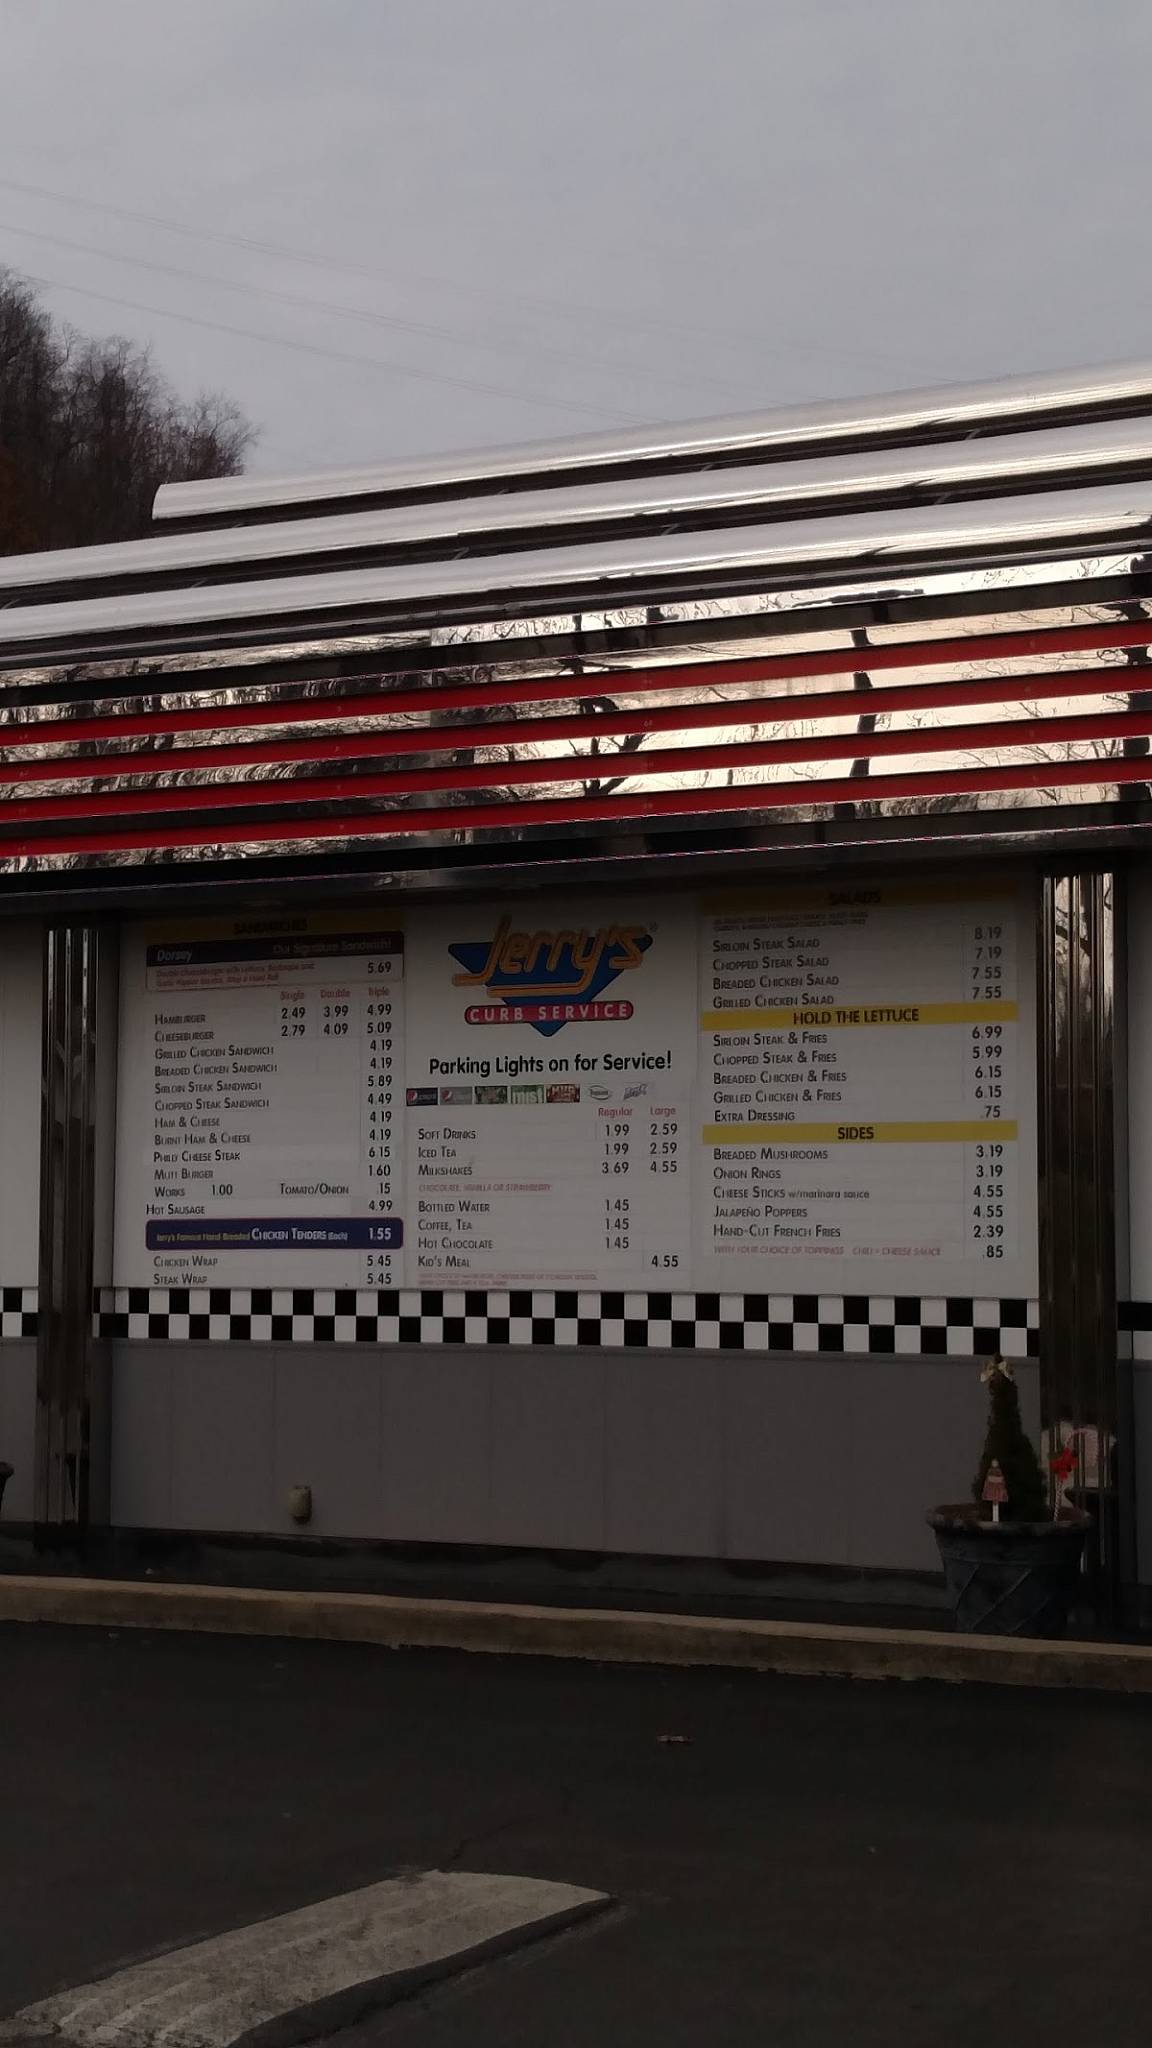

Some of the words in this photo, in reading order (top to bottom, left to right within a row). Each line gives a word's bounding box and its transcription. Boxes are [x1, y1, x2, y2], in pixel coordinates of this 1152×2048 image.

[753, 938, 784, 950] STEAK
[788, 936, 819, 948] SALAD
[975, 927, 1001, 940] 8.19
[451, 914, 648, 998] Jerry's
[713, 959, 758, 970] CHOPPED
[762, 957, 793, 968] STEAK
[797, 955, 829, 966] SALAD
[976, 946, 1001, 959] 7.19
[368, 961, 392, 973] 5.69
[713, 978, 755, 990] BREADED
[760, 976, 803, 987] CHICKEN
[807, 974, 839, 986] SALAD
[972, 966, 1001, 979] 7.55
[713, 997, 751, 1009] GRILLED
[755, 995, 798, 1006] CHICKEN
[802, 994, 834, 1005] SALAD
[972, 986, 1001, 999] 7.55
[281, 1007, 305, 1019] 2.49
[324, 1005, 348, 1017] 3.99
[368, 1004, 392, 1015] 4.99
[470, 1005, 523, 1022] CURB
[538, 1002, 628, 1020] SERVICE
[794, 1012, 831, 1025] HOLD
[837, 1011, 859, 1023] THE
[864, 1009, 918, 1022] LETTUCE
[281, 1025, 305, 1037] 2.79
[324, 1023, 348, 1035] 4.09
[368, 1022, 392, 1033] 5.09
[754, 1034, 784, 1045] STEAK
[788, 1033, 798, 1045] &
[802, 1033, 827, 1044] FRIES
[972, 1026, 1002, 1039] 6.99
[229, 1045, 273, 1056] SANDWICH
[370, 1040, 392, 1051] 4.19
[713, 1054, 759, 1066] CHOPPED
[763, 1052, 793, 1063] STEAK
[798, 1052, 807, 1063] &
[812, 1051, 837, 1063] FRIES
[972, 1046, 1002, 1059] 5.99
[155, 1066, 189, 1076] BREADED
[233, 1063, 277, 1073] SANDWICH
[370, 1058, 392, 1068] 4.19
[429, 1056, 490, 1077] Parking
[496, 1055, 543, 1076] Lights
[549, 1057, 568, 1071] on
[575, 1054, 597, 1071] for
[603, 1051, 672, 1071] Service!
[714, 1073, 756, 1084] BREADED
[760, 1071, 803, 1083] CHICKEN
[808, 1071, 817, 1082] &
[822, 1070, 847, 1082] FRIES
[975, 1066, 1001, 1079] 6.15
[188, 1082, 213, 1093] STEAK
[217, 1081, 261, 1091] SANDWICH
[368, 1075, 392, 1087] 5.89
[155, 1100, 192, 1111] CHOPPED
[196, 1099, 221, 1109] STEAK
[224, 1098, 269, 1108] SANDWICH
[368, 1093, 392, 1104] 4.49
[714, 1091, 752, 1103] GRILLED
[756, 1090, 798, 1102] CHICKEN
[802, 1090, 812, 1101] &
[816, 1090, 841, 1101] FRIES
[975, 1086, 1001, 1098] 6.15
[155, 1117, 175, 1128] HAM
[179, 1117, 186, 1127] &
[190, 1116, 220, 1127] CHEESE
[370, 1111, 392, 1123] 4.19
[599, 1107, 632, 1118] Regular
[650, 1106, 676, 1117] Large
[714, 1111, 743, 1121] EXTRA
[748, 1110, 795, 1121] DRESSING
[184, 1133, 205, 1144] HAM
[209, 1133, 217, 1143] &
[221, 1133, 250, 1143] CHEESE
[369, 1129, 391, 1141] 4.19
[418, 1128, 440, 1140] SOFT
[444, 1128, 476, 1139] DRINKS
[605, 1125, 629, 1136] 1.99
[650, 1123, 678, 1136] 2.59
[838, 1127, 874, 1140] SIDES
[182, 1151, 211, 1161] CHEESE
[215, 1150, 240, 1160] STEAK
[369, 1147, 390, 1158] 6.15
[418, 1147, 436, 1158] ICED
[441, 1146, 456, 1157] TEA
[604, 1143, 628, 1155] 1.99
[650, 1142, 677, 1154] 2.59
[714, 1149, 756, 1160] BREADED
[761, 1148, 828, 1159] MUSHROOMS
[976, 1145, 1003, 1158] 3.19
[602, 1162, 628, 1174] 3.69
[650, 1161, 677, 1173] 4.55
[714, 1168, 747, 1180] ONION
[752, 1167, 781, 1179] RINGS
[976, 1165, 1003, 1177] 3.19
[155, 1186, 185, 1197] WORKS
[212, 1184, 233, 1195] 1.00
[713, 1186, 748, 1198] CHEESE
[753, 1186, 785, 1198] STICKS
[844, 1190, 869, 1199] sauce
[974, 1185, 1003, 1198] 4.55
[147, 1204, 164, 1214] HOT
[168, 1203, 205, 1214] SAUSAGE
[369, 1201, 392, 1211] 4.99
[418, 1201, 455, 1212] BOTTLED
[459, 1201, 490, 1212] WATER
[605, 1199, 629, 1211] 1.45
[765, 1205, 807, 1217] POPPERS
[973, 1205, 1003, 1219] 4.55
[456, 1219, 472, 1230] TEA
[605, 1218, 629, 1230] 1.45
[252, 1228, 288, 1241] CHICKEN
[292, 1228, 327, 1241] TENDERS
[369, 1228, 391, 1240] 1.55
[774, 1225, 811, 1237] FRENCH
[816, 1225, 841, 1237] FRIES
[974, 1225, 1003, 1239] 2.39
[418, 1238, 437, 1249] HOT
[442, 1237, 493, 1249] CHOCOLATE
[605, 1237, 629, 1249] 1.45
[154, 1256, 189, 1267] CHICKEN
[192, 1255, 218, 1266] WRAP
[367, 1255, 391, 1266] 5.45
[446, 1256, 470, 1267] MEAL
[651, 1256, 678, 1267] 4.55
[154, 1273, 178, 1285] STEAK
[182, 1273, 207, 1284] WRAP
[367, 1273, 392, 1284] 5.45
